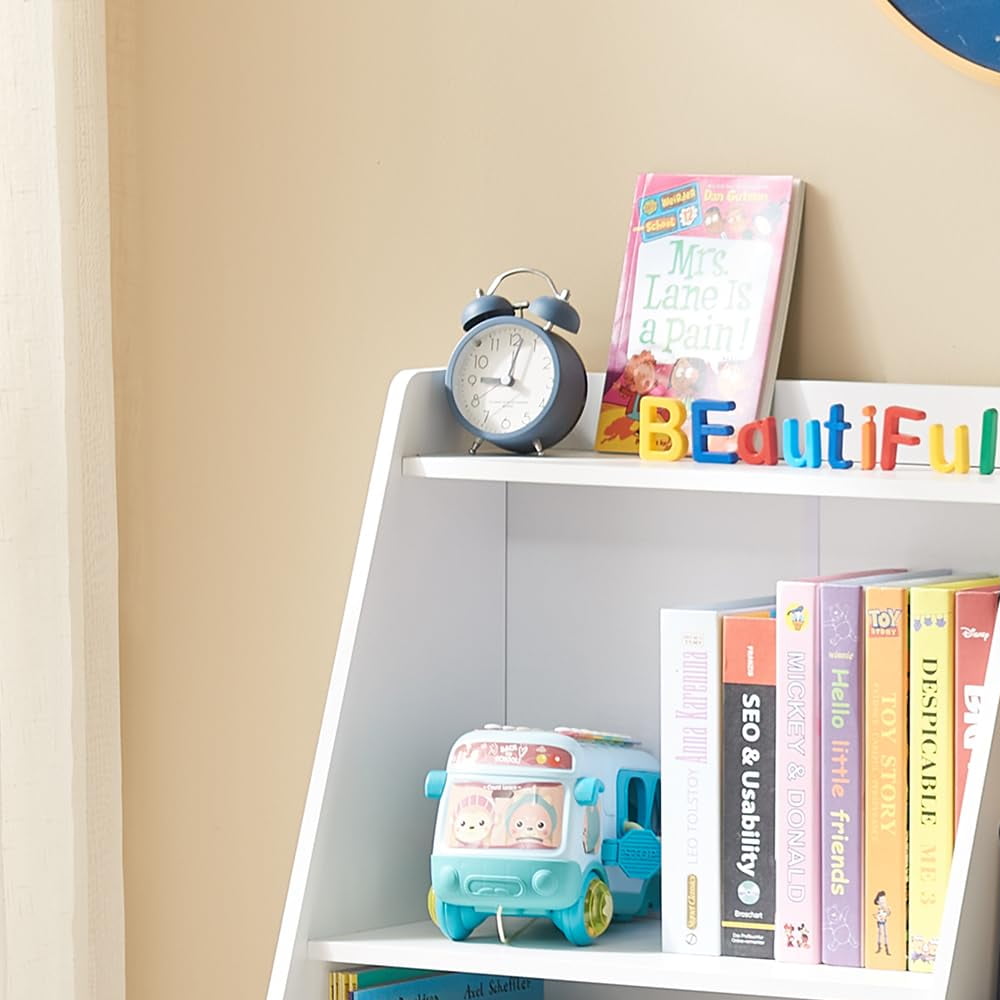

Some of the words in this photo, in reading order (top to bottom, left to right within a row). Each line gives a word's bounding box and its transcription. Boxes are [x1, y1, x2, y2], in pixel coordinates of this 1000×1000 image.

[668, 239, 728, 279] Mrs.
[643, 274, 719, 311] Lane
[725, 279, 752, 310] Is
[639, 318, 656, 345] a
[662, 315, 749, 353] Pain!
[468, 375, 477, 386] 9
[474, 354, 489, 369] 10
[868, 608, 903, 630] TOY
[676, 650, 708, 720] Karenina
[786, 652, 806, 754] MICKEY
[831, 668, 850, 729] Hello
[739, 692, 761, 742] SEO
[880, 692, 896, 744] TOY
[676, 727, 708, 764] Anna
[739, 746, 761, 766] &
[920, 658, 938, 826] DESPICABLE
[786, 764, 806, 780] &
[830, 740, 850, 799] little
[686, 768, 699, 832] TOLSTOY
[880, 754, 896, 837] STORY
[736, 770, 761, 878] Usability
[686, 837, 699, 864] LEO
[786, 789, 806, 904] DONALD
[830, 808, 850, 896] friends
[920, 844, 937, 883] ME
[920, 890, 937, 906] 3
[464, 983, 484, 1000] Axel
